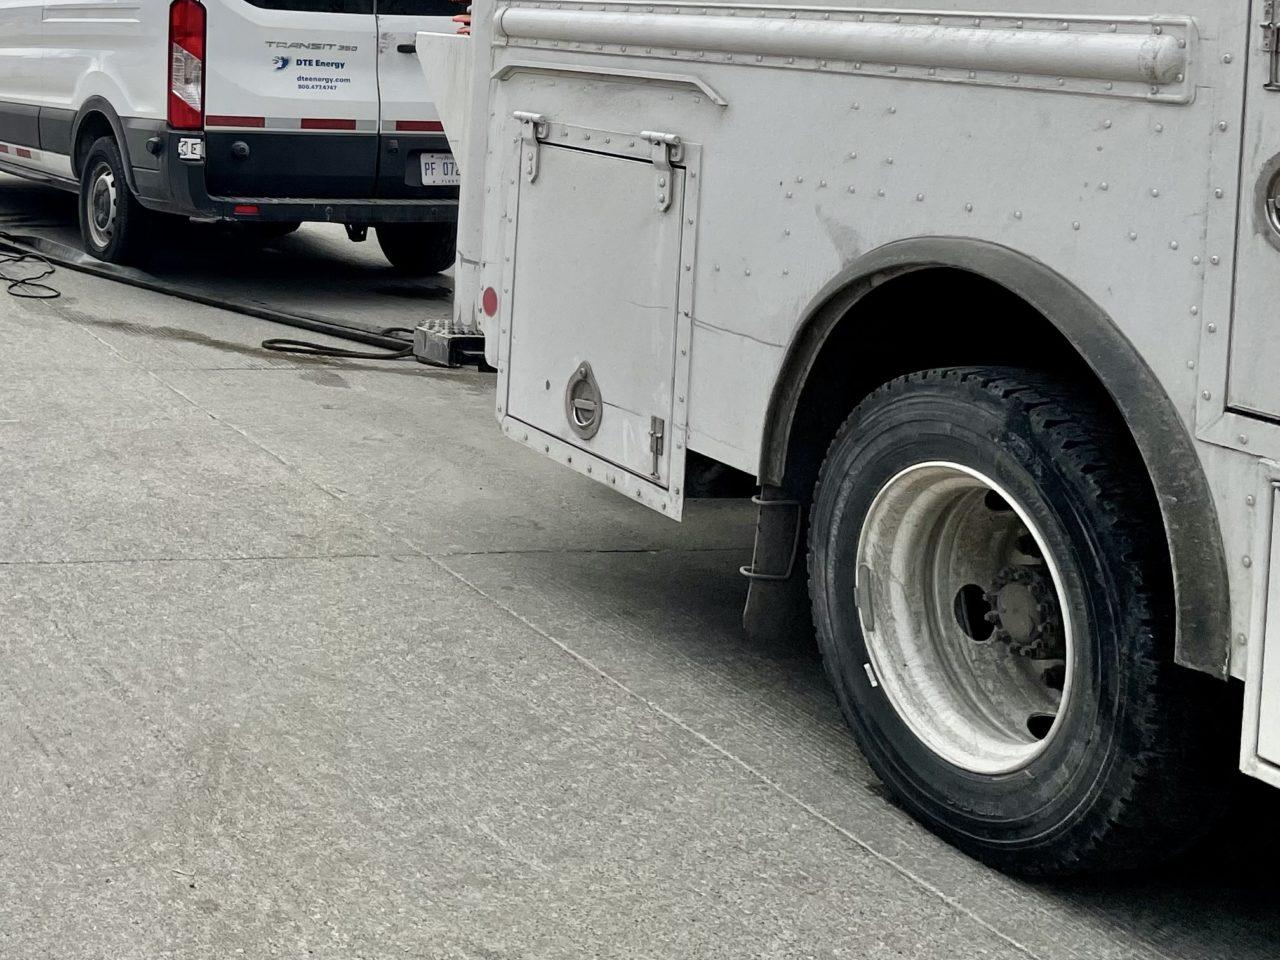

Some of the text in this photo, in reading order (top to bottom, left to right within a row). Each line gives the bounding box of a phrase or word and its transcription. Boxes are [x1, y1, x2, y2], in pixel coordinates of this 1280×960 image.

[265, 40, 336, 50] TRANSIT
[296, 59, 345, 69] DTE Energy
[297, 75, 351, 84] dteenergy.com
[425, 162, 436, 176] PF
